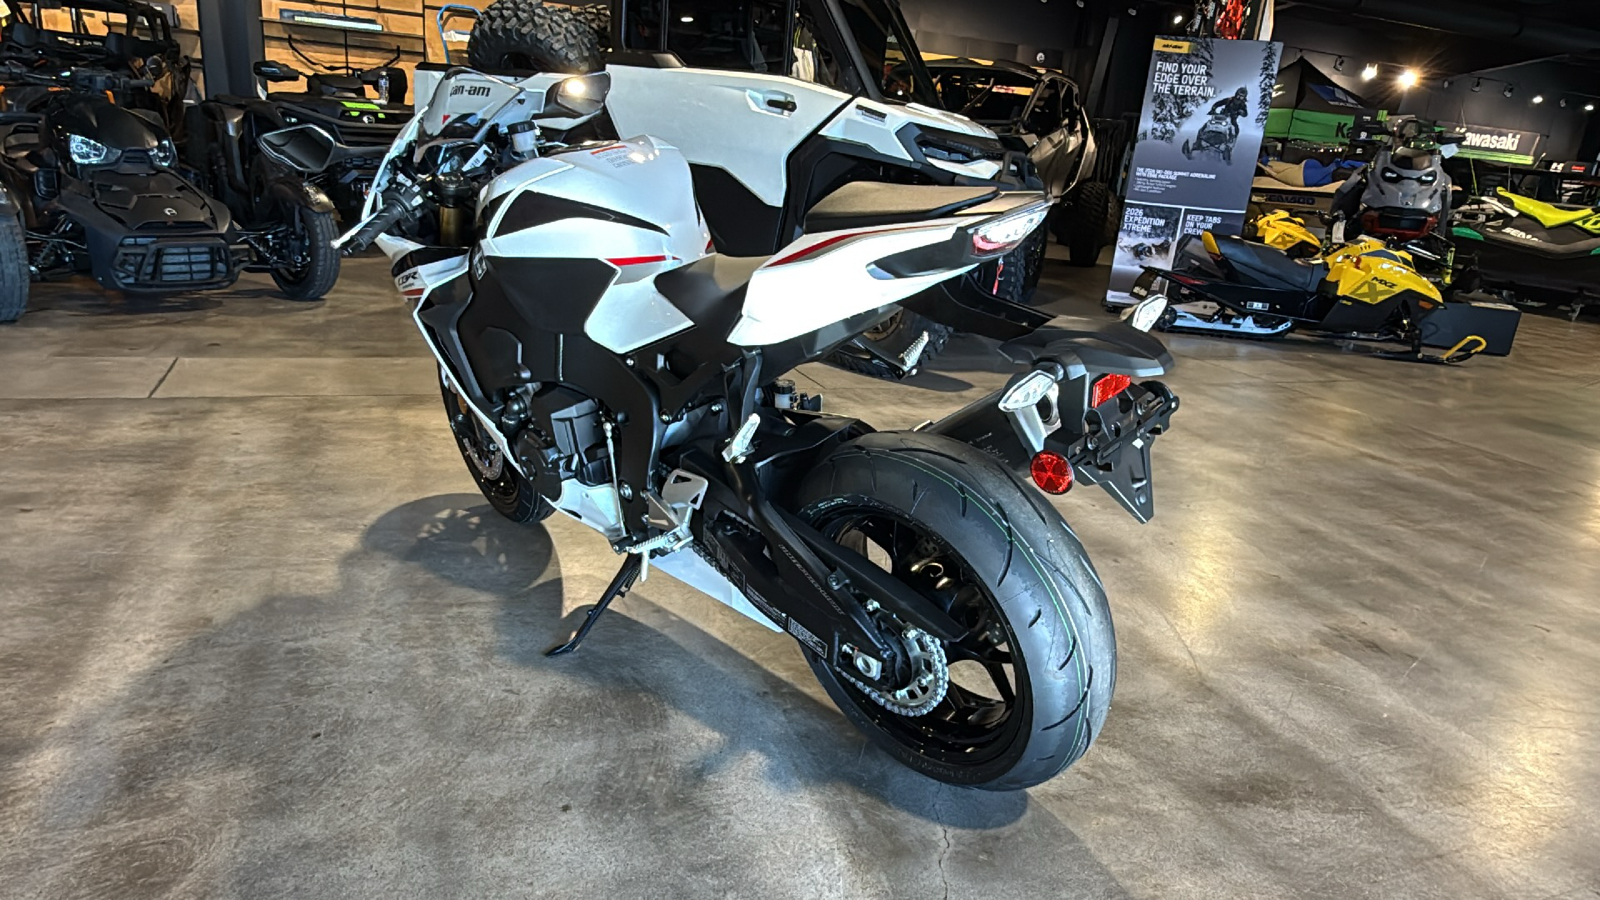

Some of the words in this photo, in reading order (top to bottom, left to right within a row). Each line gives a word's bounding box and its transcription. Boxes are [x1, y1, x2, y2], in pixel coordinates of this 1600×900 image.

[1156, 61, 1178, 73] FIND
[1181, 63, 1207, 75] YOUR
[1154, 72, 1179, 84] EDGE
[1181, 74, 1207, 86] OVER
[1153, 82, 1171, 94] THE
[1173, 85, 1217, 97] TERRAIN.
[1455, 127, 1521, 151] awasaki
[1125, 208, 1143, 216] 2026
[1124, 215, 1165, 226] EXPEDITION
[1186, 214, 1204, 222] KEEP
[1123, 223, 1152, 233] XTREME
[1196, 222, 1213, 230] YOUR
